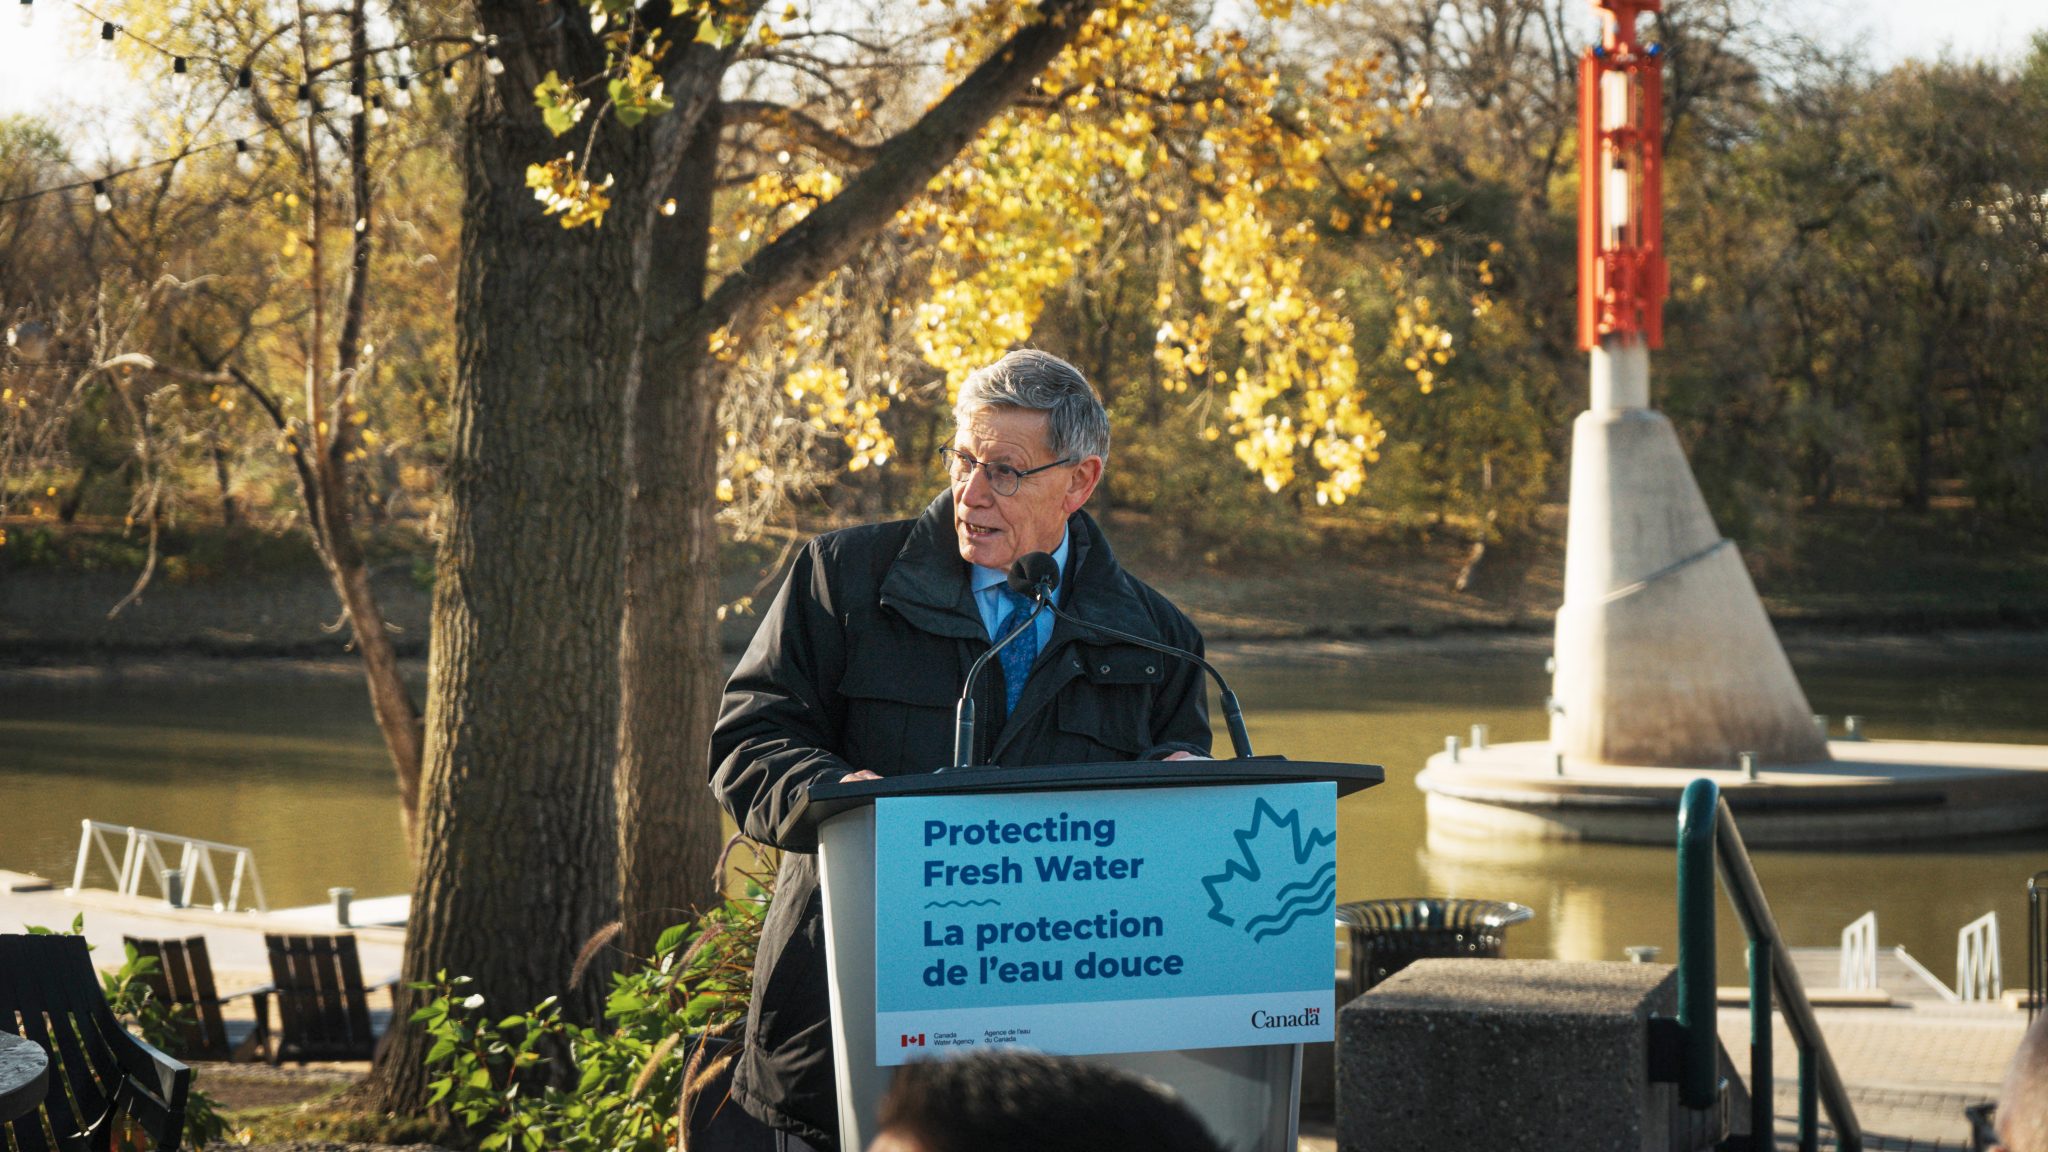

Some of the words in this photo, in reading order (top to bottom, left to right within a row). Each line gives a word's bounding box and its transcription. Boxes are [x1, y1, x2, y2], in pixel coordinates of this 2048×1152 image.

[924, 812, 1116, 848] Protecting
[924, 857, 1023, 888] Fresh
[1034, 855, 1145, 883] Water
[923, 920, 964, 947] La
[976, 910, 1164, 951] protection
[922, 958, 969, 987] de
[979, 957, 1063, 985] l’eau
[1074, 952, 1185, 980] douce
[1251, 1008, 1320, 1029] Canada
[952, 1038, 975, 1046] Agency
